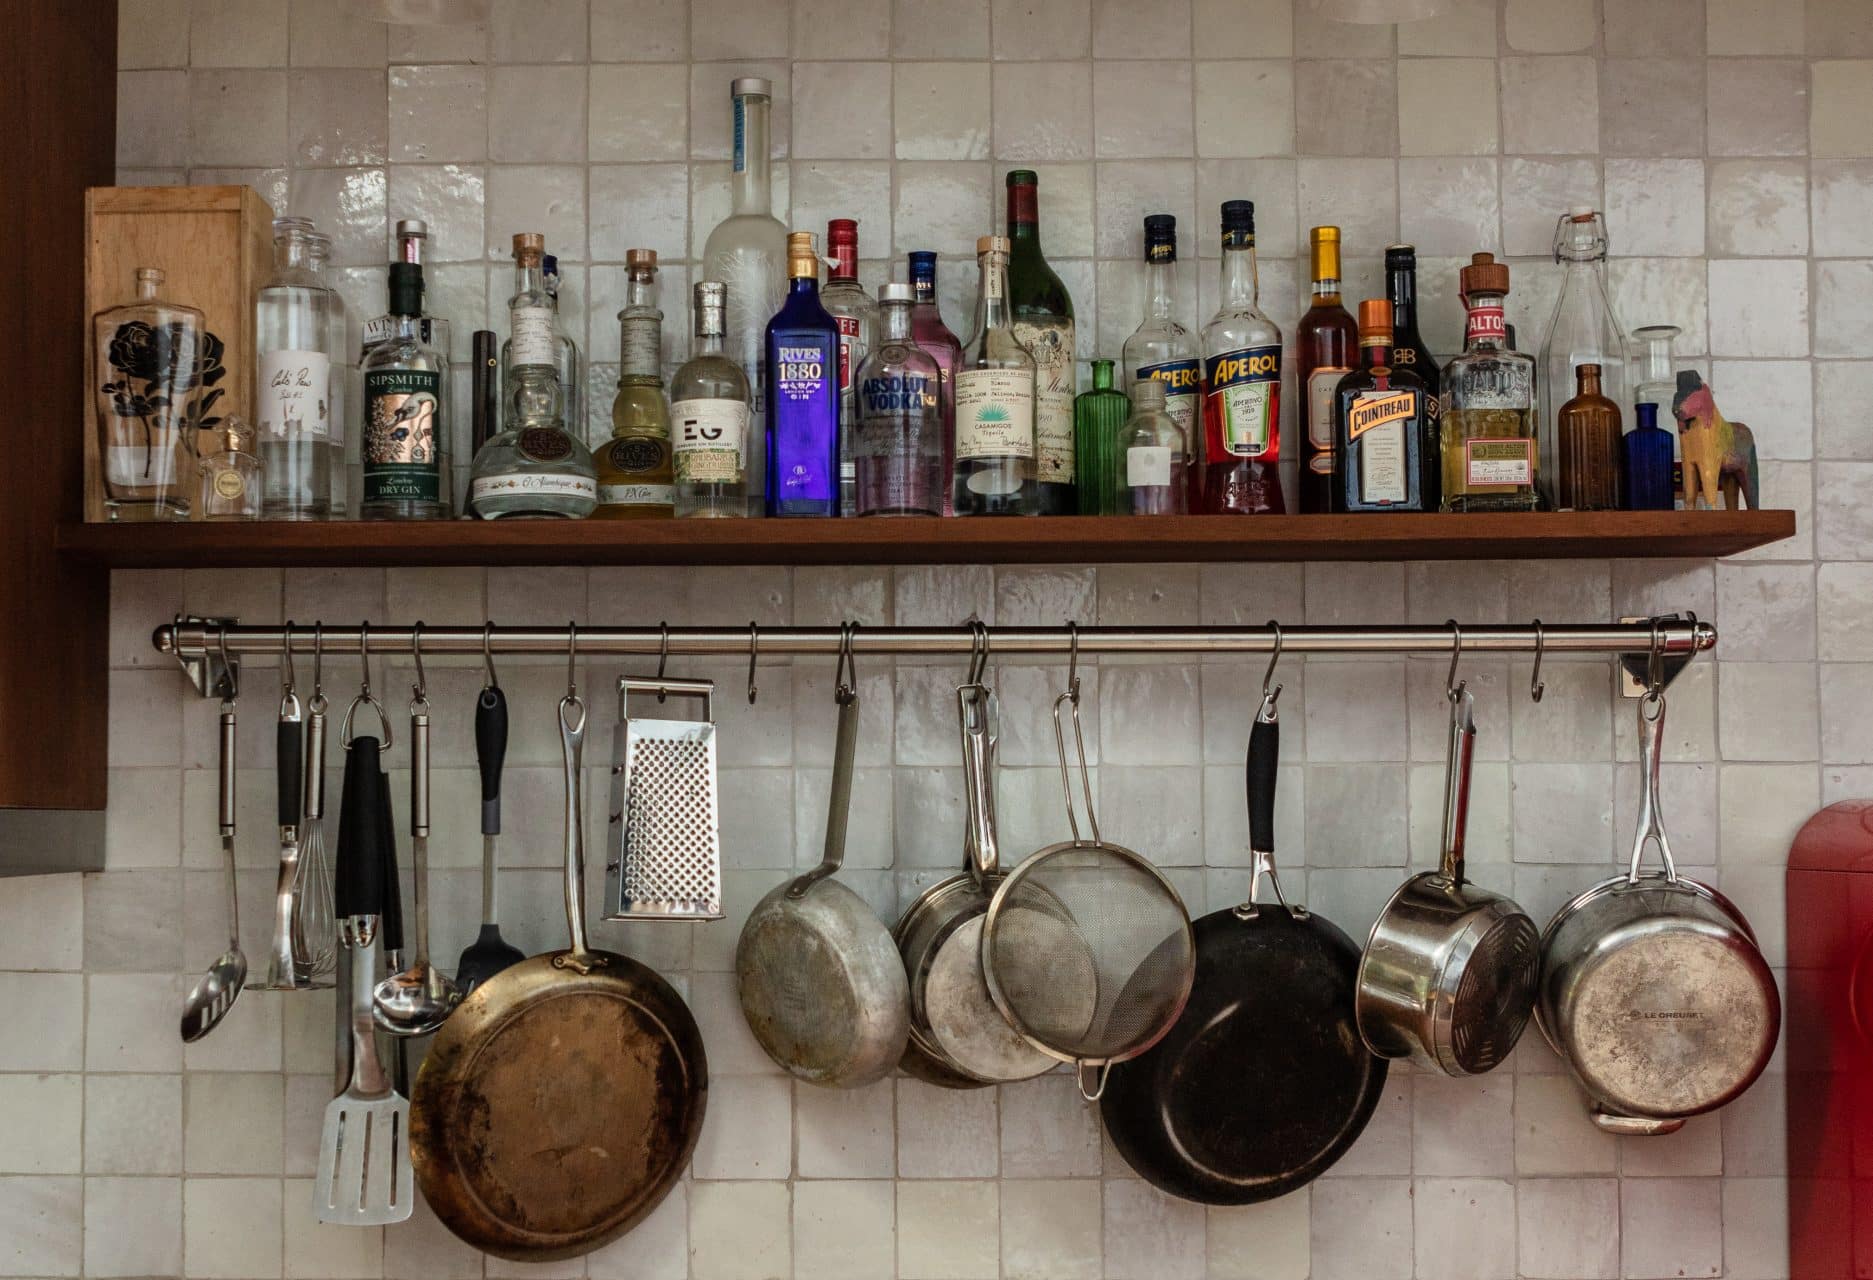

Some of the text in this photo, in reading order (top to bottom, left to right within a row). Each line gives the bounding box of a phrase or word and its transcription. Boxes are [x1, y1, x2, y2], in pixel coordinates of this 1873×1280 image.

[779, 347, 822, 363] RIVES
[778, 362, 822, 381] 1880
[1213, 355, 1278, 386] APEROL
[369, 374, 432, 387] SIPSMITH
[863, 374, 929, 395] ABSOLUT
[868, 393, 924, 411] VODKA
[1353, 398, 1411, 432] COINTREAU
[684, 420, 723, 441] EG
[379, 486, 421, 495] DRY GIN
